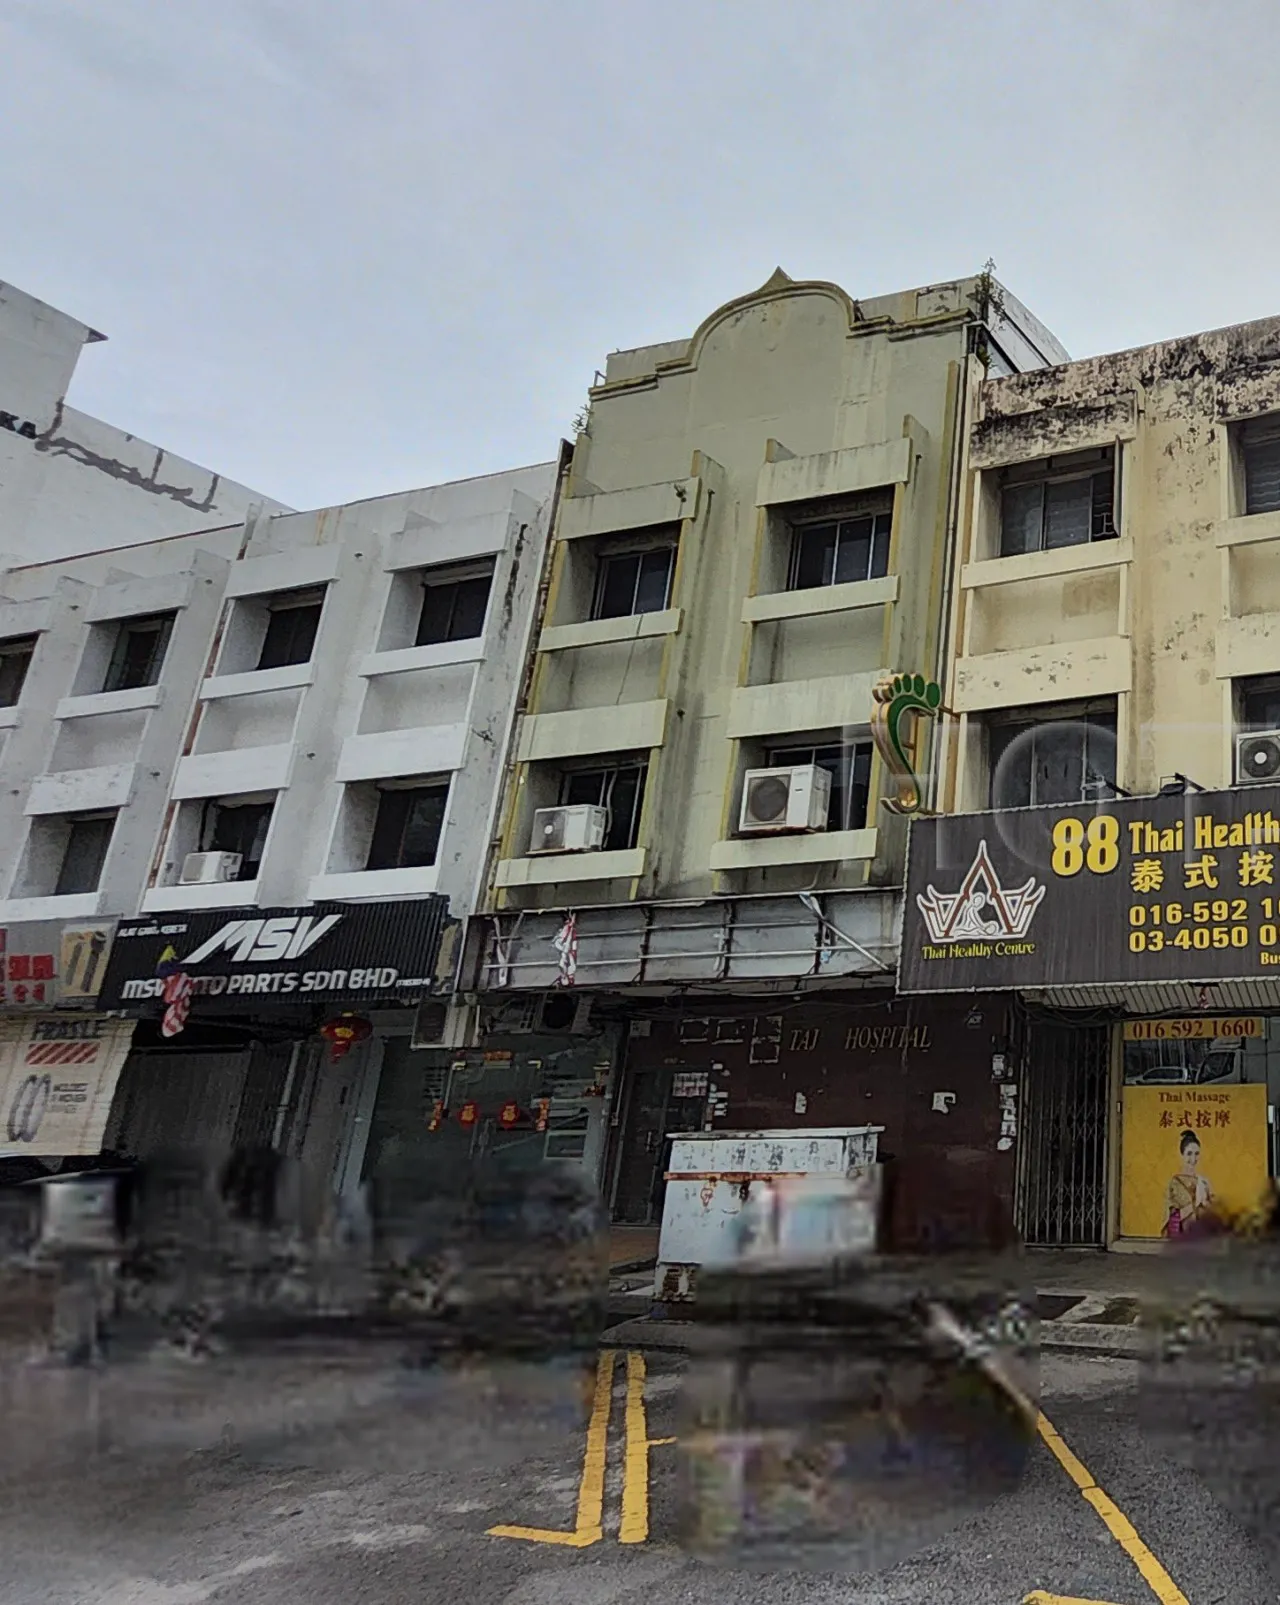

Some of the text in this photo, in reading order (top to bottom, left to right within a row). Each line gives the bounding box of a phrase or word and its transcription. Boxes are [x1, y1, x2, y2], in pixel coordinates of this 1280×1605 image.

[1052, 816, 1120, 876] 88
[1129, 820, 1184, 855] Thai
[1129, 899, 1248, 926] 016-592
[180, 914, 342, 963] MSV
[922, 942, 1035, 959] Thai Healthy Centre
[1129, 926, 1249, 952] 03-4050
[226, 972, 299, 994] PARTS
[300, 970, 348, 992] SDN
[349, 968, 398, 989] BHD
[789, 1026, 931, 1052] TAJ HOSPITAL
[1132, 1019, 1255, 1038] 016 592 1660
[1158, 1091, 1231, 1104] Thai Massage
[1159, 1109, 1231, 1128] 泰式按摩
